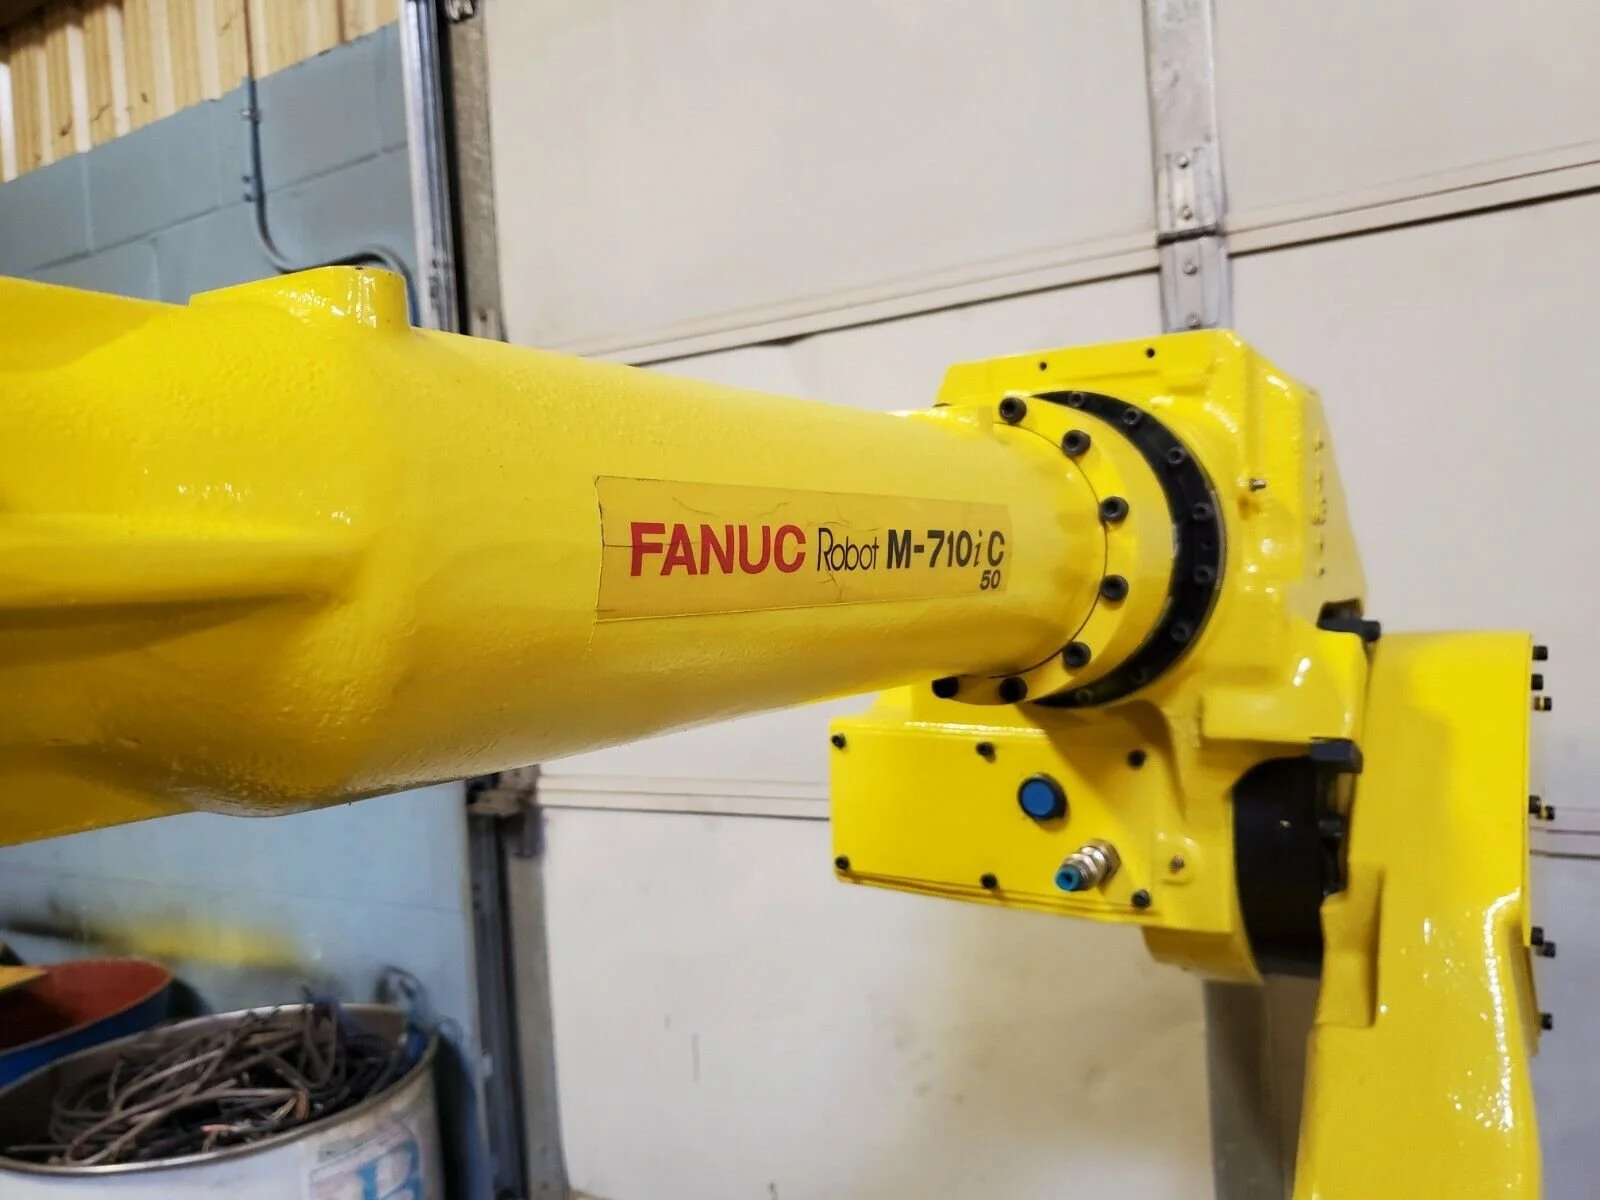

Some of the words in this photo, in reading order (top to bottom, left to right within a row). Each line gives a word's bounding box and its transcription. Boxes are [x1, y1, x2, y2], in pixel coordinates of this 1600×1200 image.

[630, 521, 806, 576] FANUC
[816, 527, 880, 571] Robot
[979, 569, 1001, 590] 50
